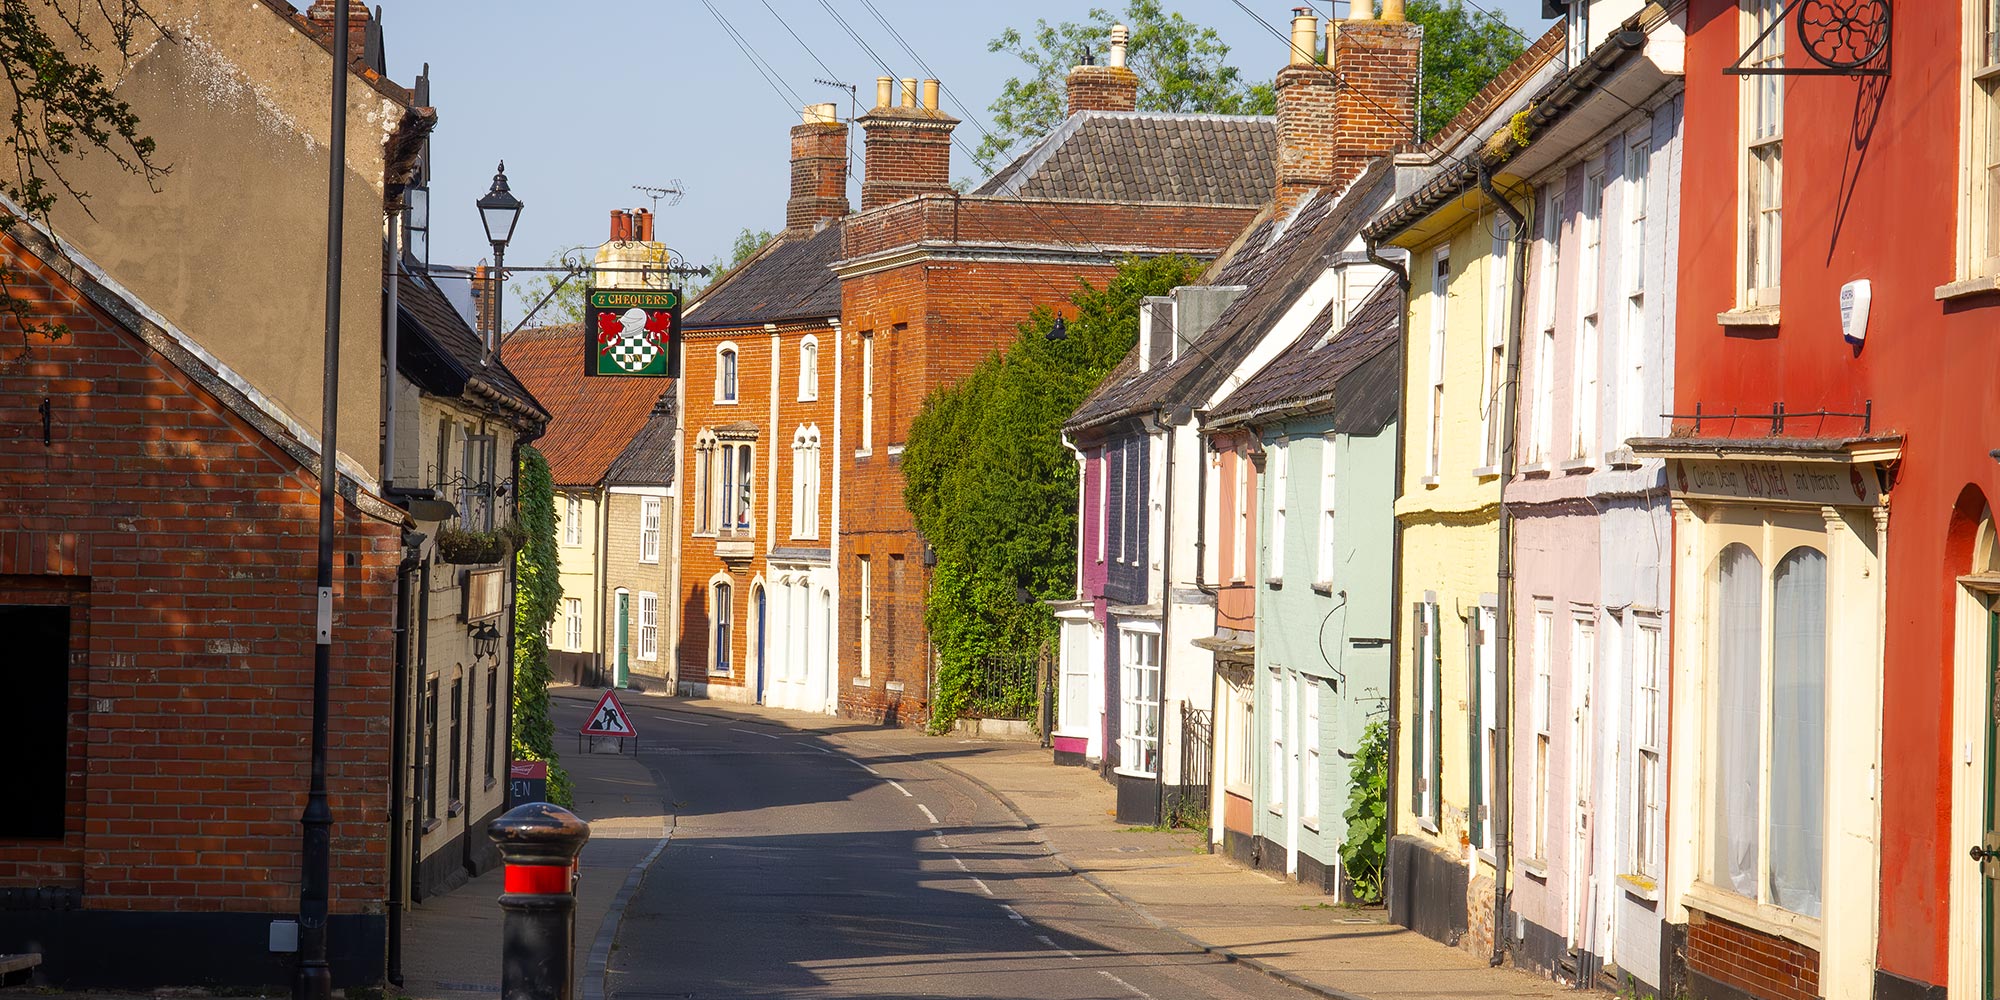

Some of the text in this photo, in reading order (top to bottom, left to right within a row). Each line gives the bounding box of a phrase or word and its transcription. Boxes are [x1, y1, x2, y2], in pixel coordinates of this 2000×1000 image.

[608, 294, 668, 307] CHEQUERS
[1693, 466, 1715, 489] Curtain
[1715, 465, 1738, 494] Design
[1793, 463, 1809, 492] and
